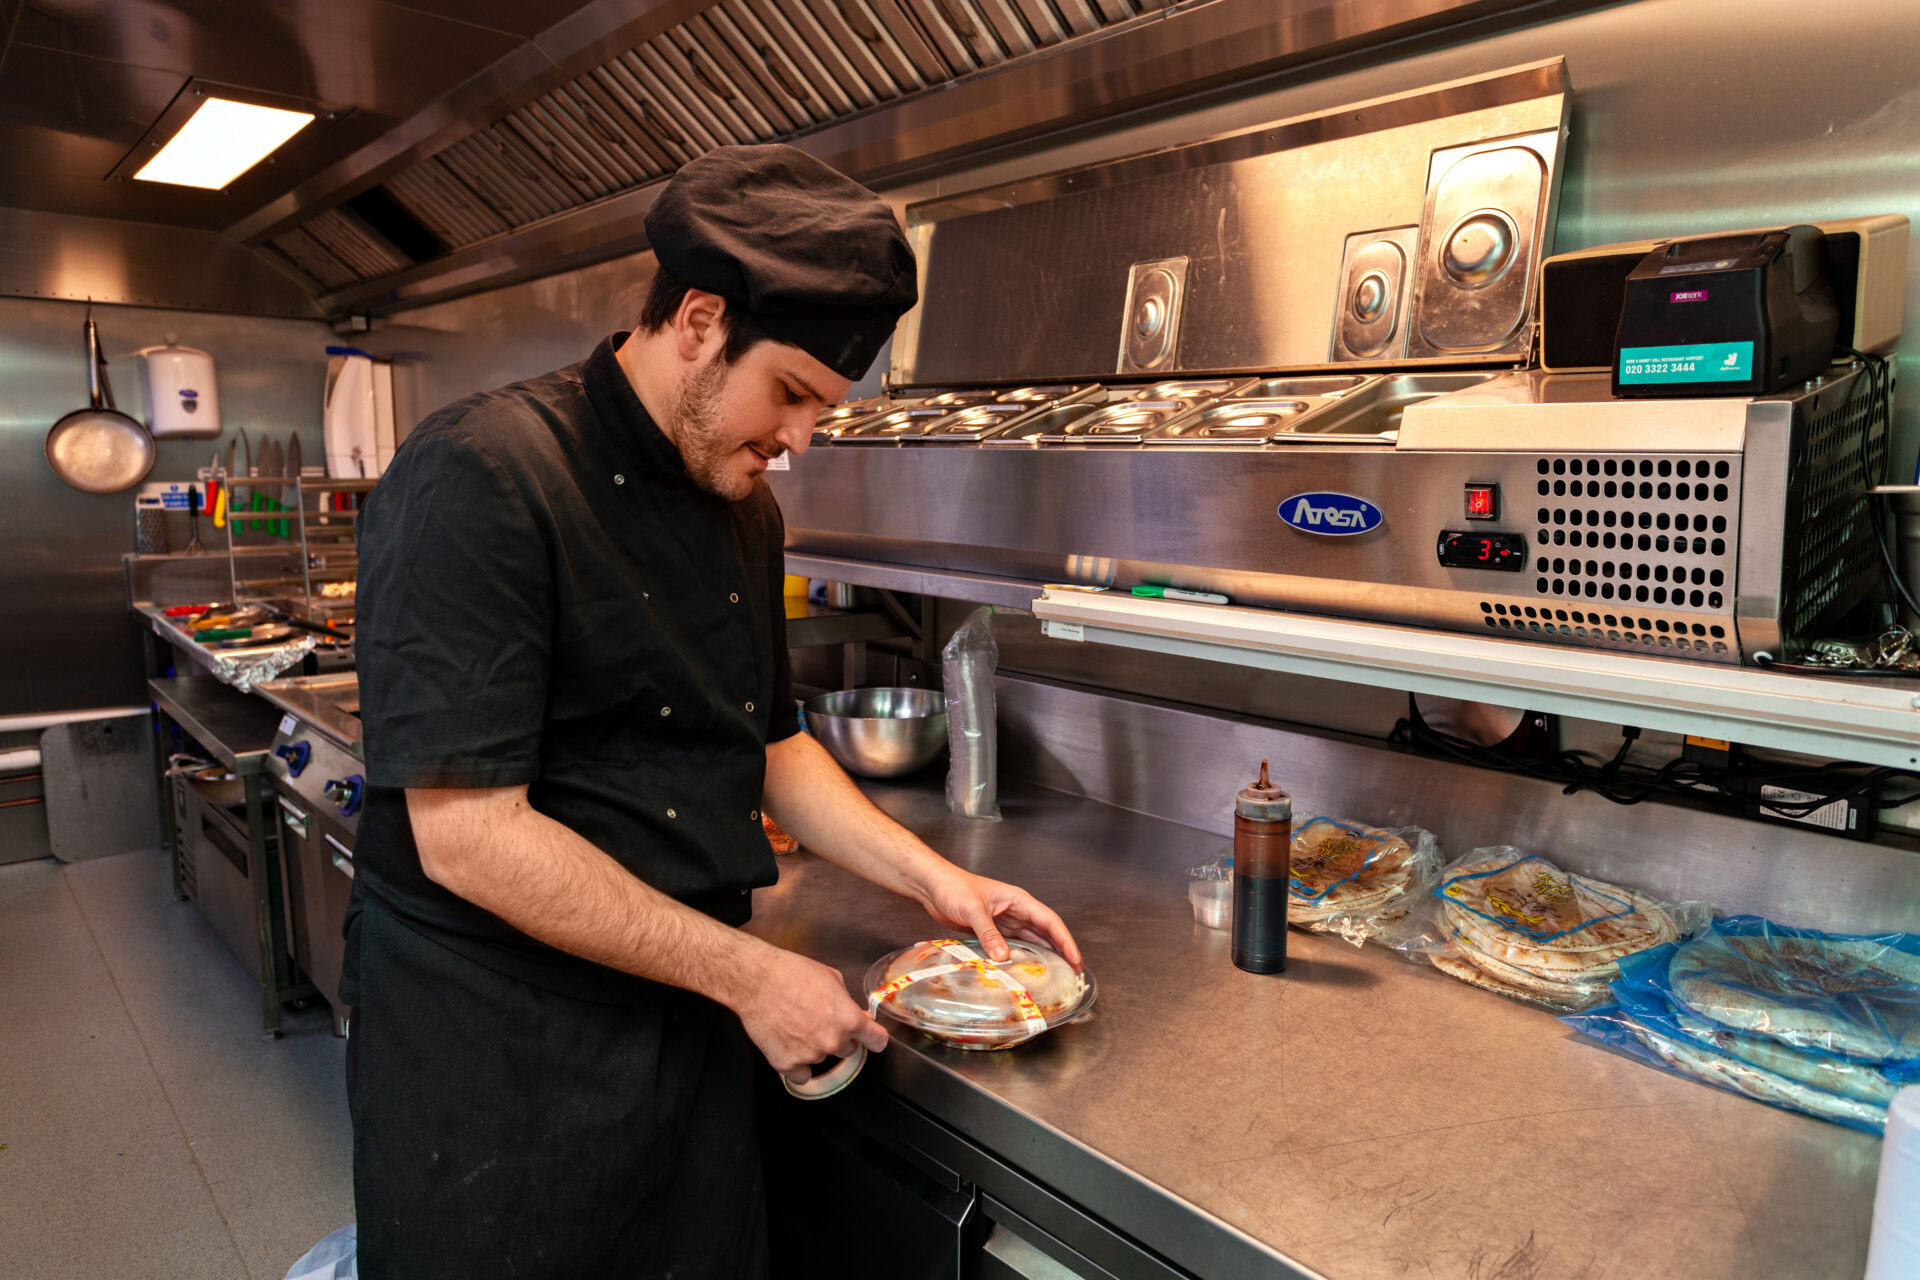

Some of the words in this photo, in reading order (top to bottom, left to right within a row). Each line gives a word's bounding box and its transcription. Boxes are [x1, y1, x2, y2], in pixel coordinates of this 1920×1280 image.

[1625, 364, 1643, 374] 020
[1644, 363, 1669, 373] 3322
[1670, 362, 1696, 372] 3444
[1478, 540, 1491, 560] 3
